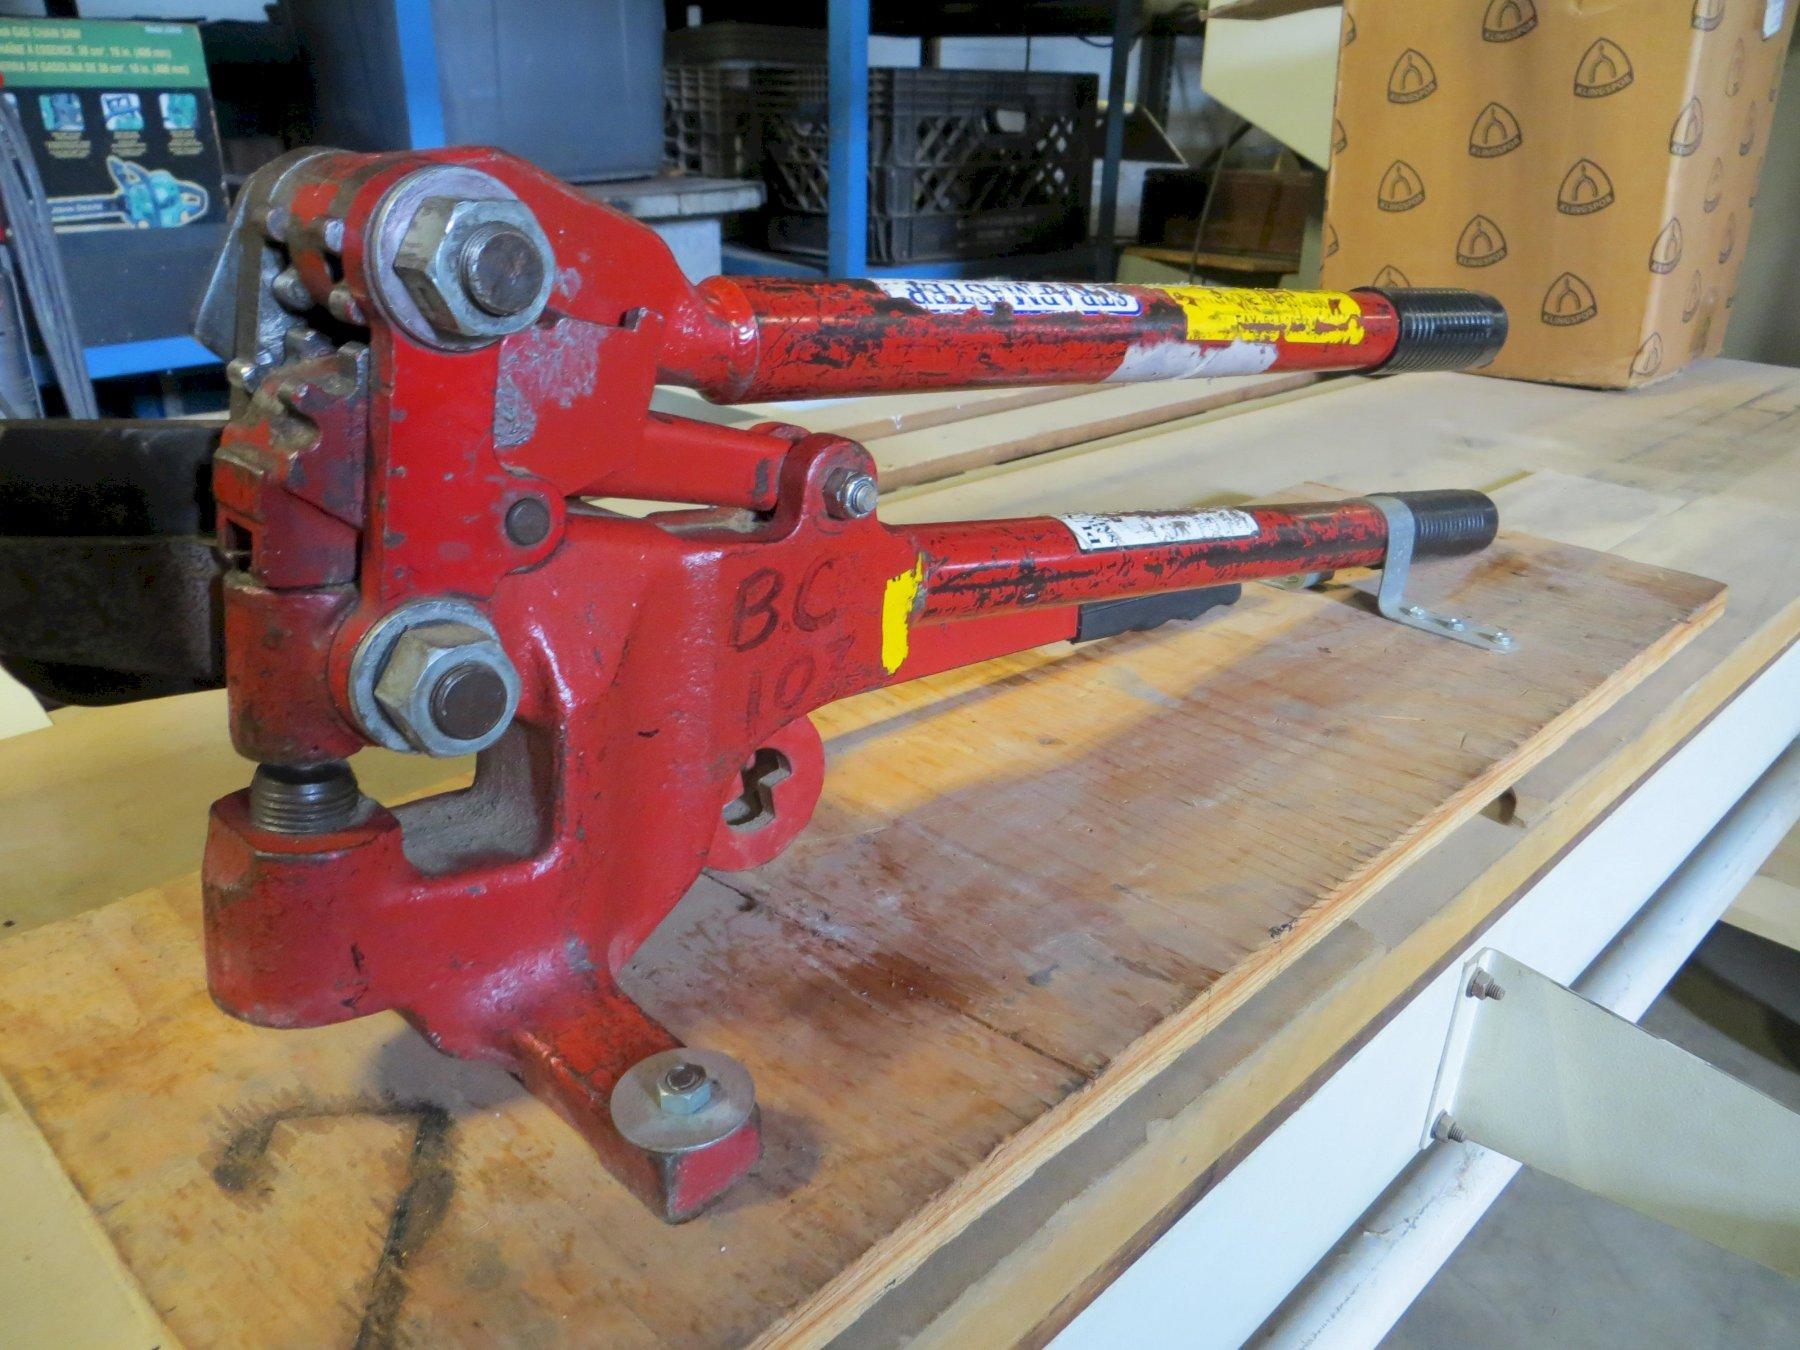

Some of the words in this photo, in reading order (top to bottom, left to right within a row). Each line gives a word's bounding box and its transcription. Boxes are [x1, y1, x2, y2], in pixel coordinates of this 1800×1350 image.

[1575, 73, 1633, 98] KLINGSPOR
[1559, 194, 1614, 214] KLINGSPOR
[1543, 307, 1597, 325] KLINGSPOR
